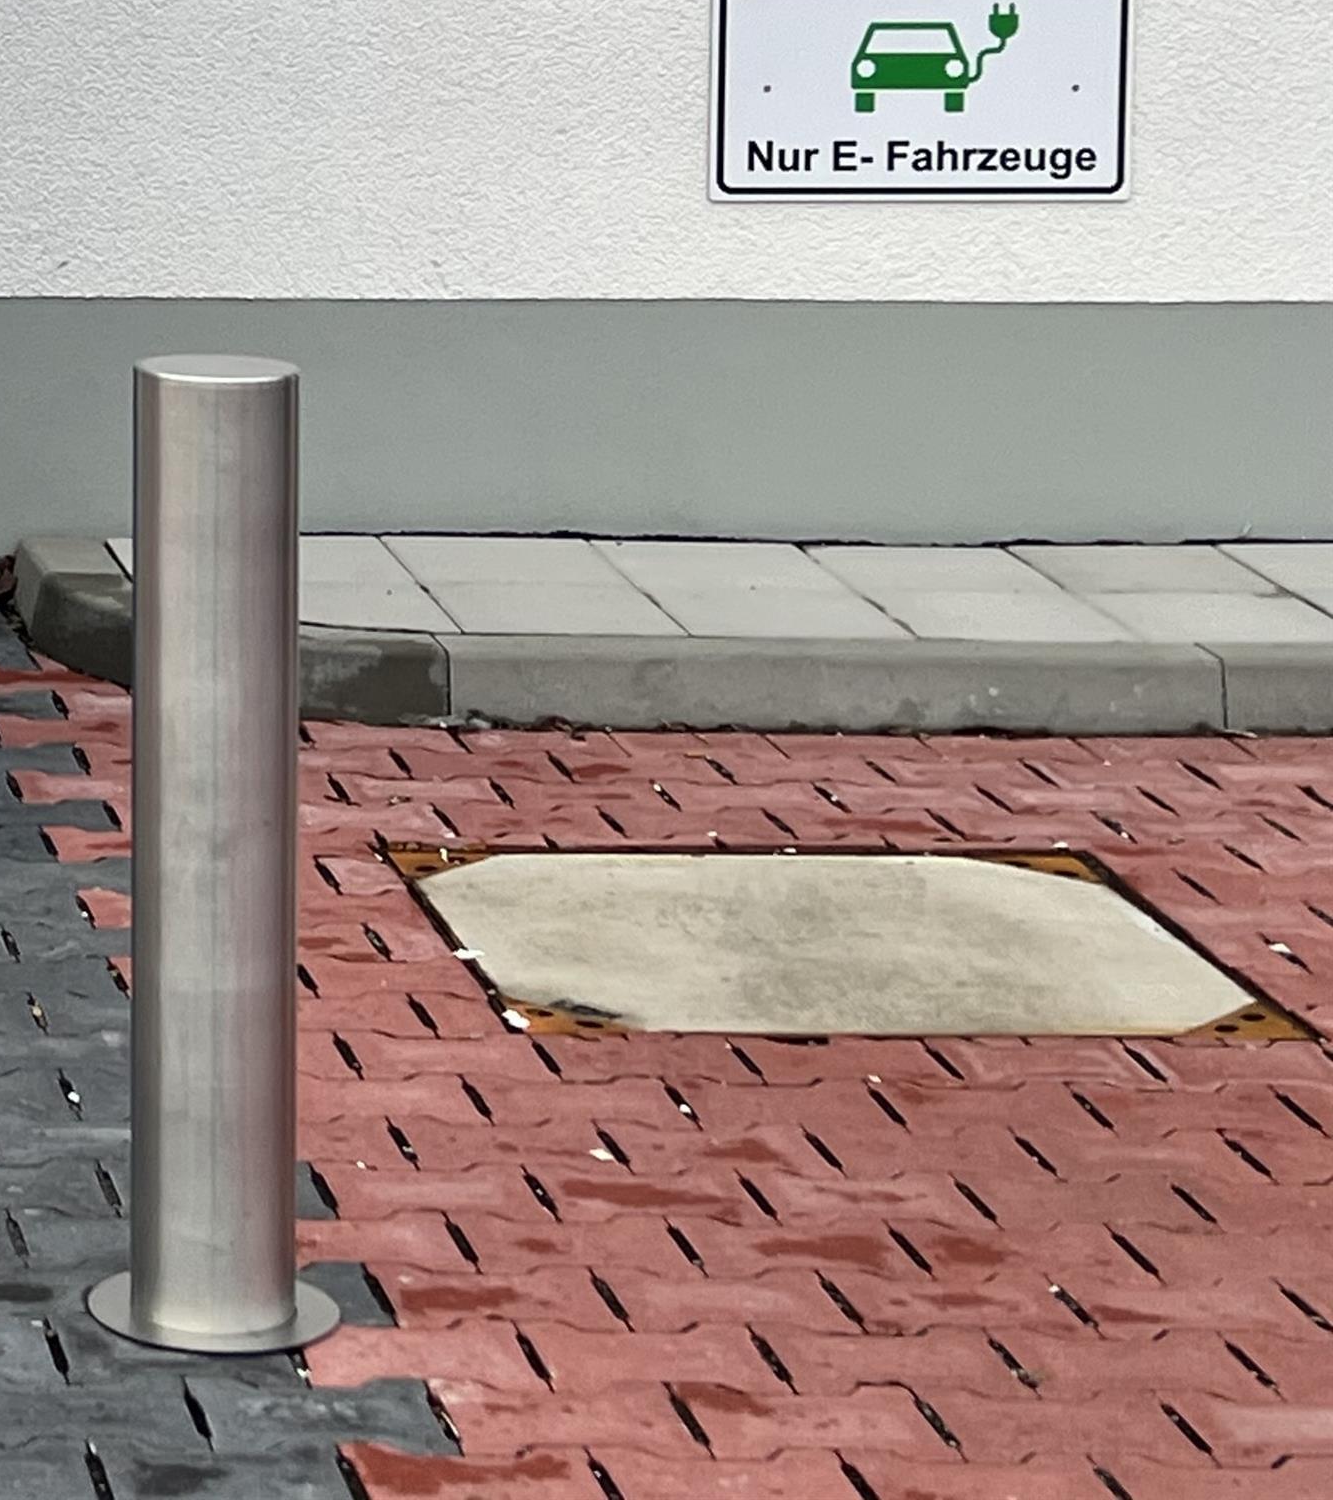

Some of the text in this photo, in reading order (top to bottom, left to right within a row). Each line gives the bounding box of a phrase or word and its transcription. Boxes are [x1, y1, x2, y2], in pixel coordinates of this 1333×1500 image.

[747, 140, 1098, 179] Nur E- Fahrzeuge
